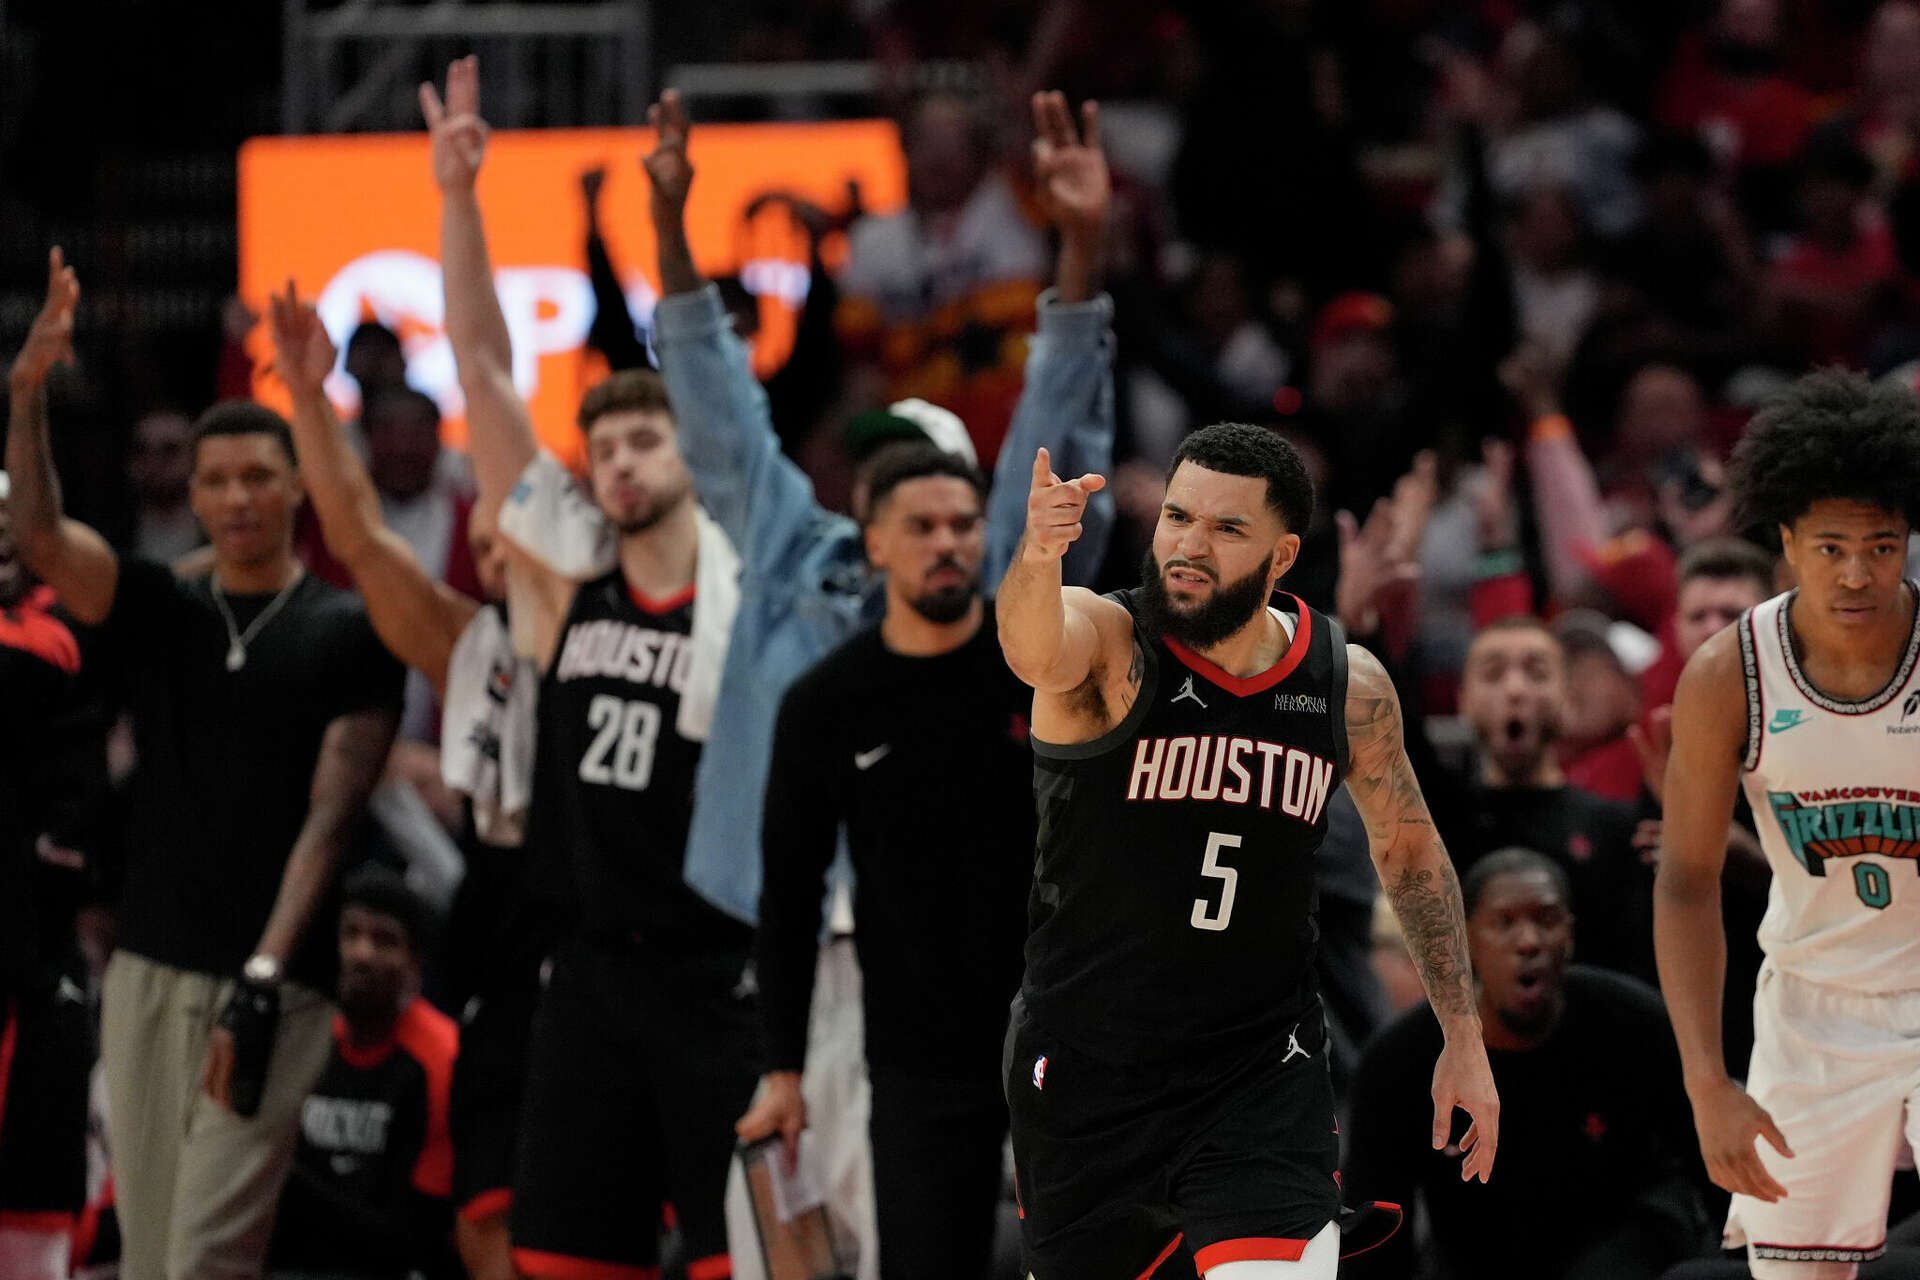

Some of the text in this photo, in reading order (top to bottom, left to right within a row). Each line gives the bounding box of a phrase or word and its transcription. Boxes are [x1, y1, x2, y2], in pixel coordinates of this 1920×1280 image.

[1274, 693, 1326, 706] MEMORIAL
[1274, 701, 1326, 714] HERMANN
[579, 693, 662, 791] 28
[1126, 735, 1334, 825] HOUSTON
[1190, 831, 1242, 931] 5
[1852, 860, 1892, 910] 0
